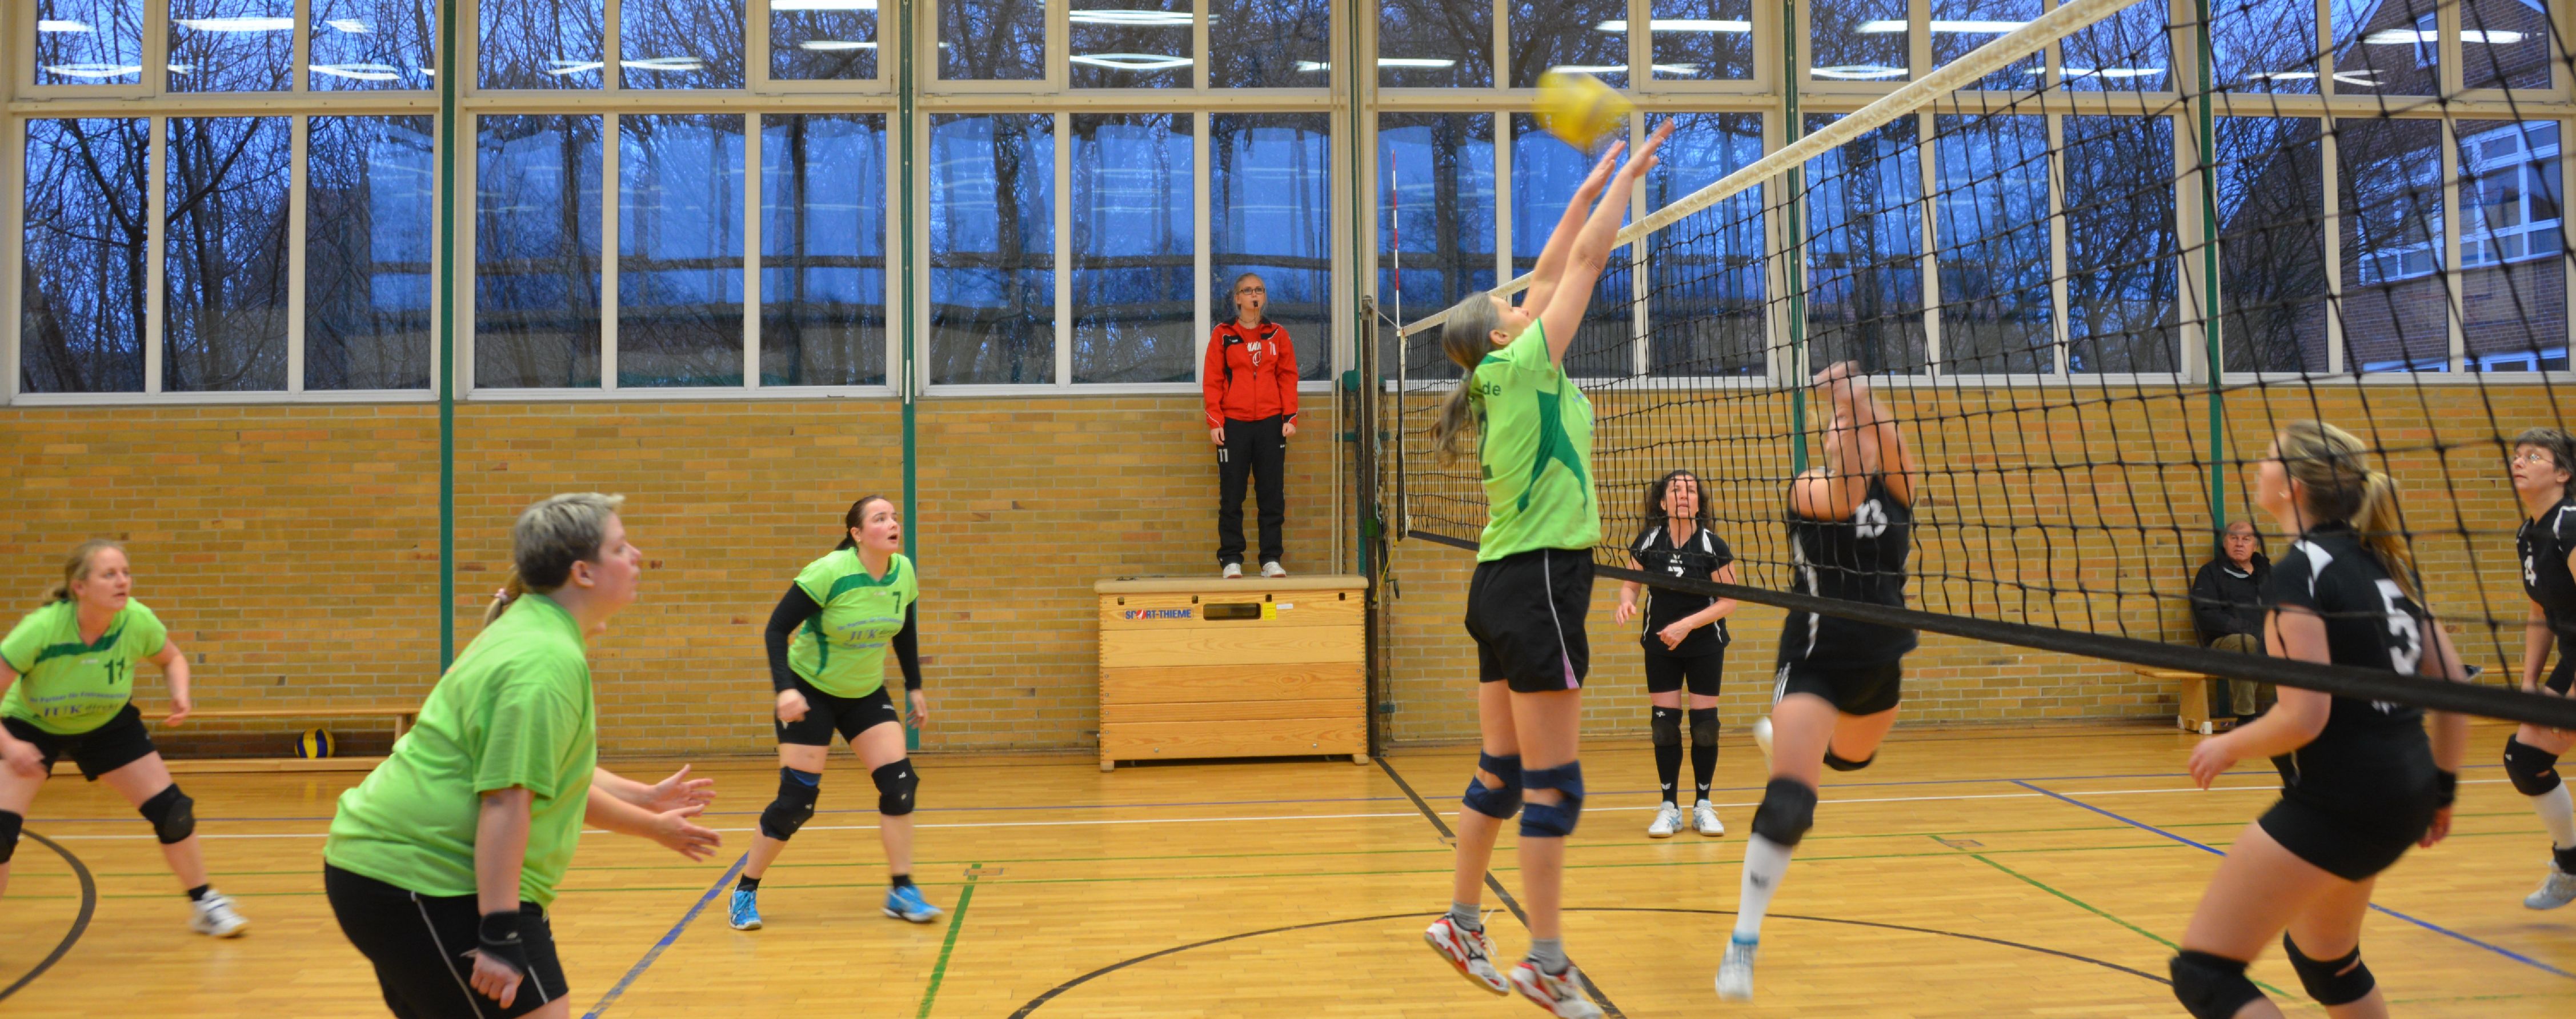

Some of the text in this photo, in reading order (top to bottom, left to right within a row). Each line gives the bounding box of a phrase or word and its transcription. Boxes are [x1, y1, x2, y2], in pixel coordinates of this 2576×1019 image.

[1218, 448, 1228, 462] 11
[2524, 555, 2537, 587] 4
[892, 591, 902, 614] 7
[2374, 578, 2422, 675] 5
[103, 658, 125, 685] 11
